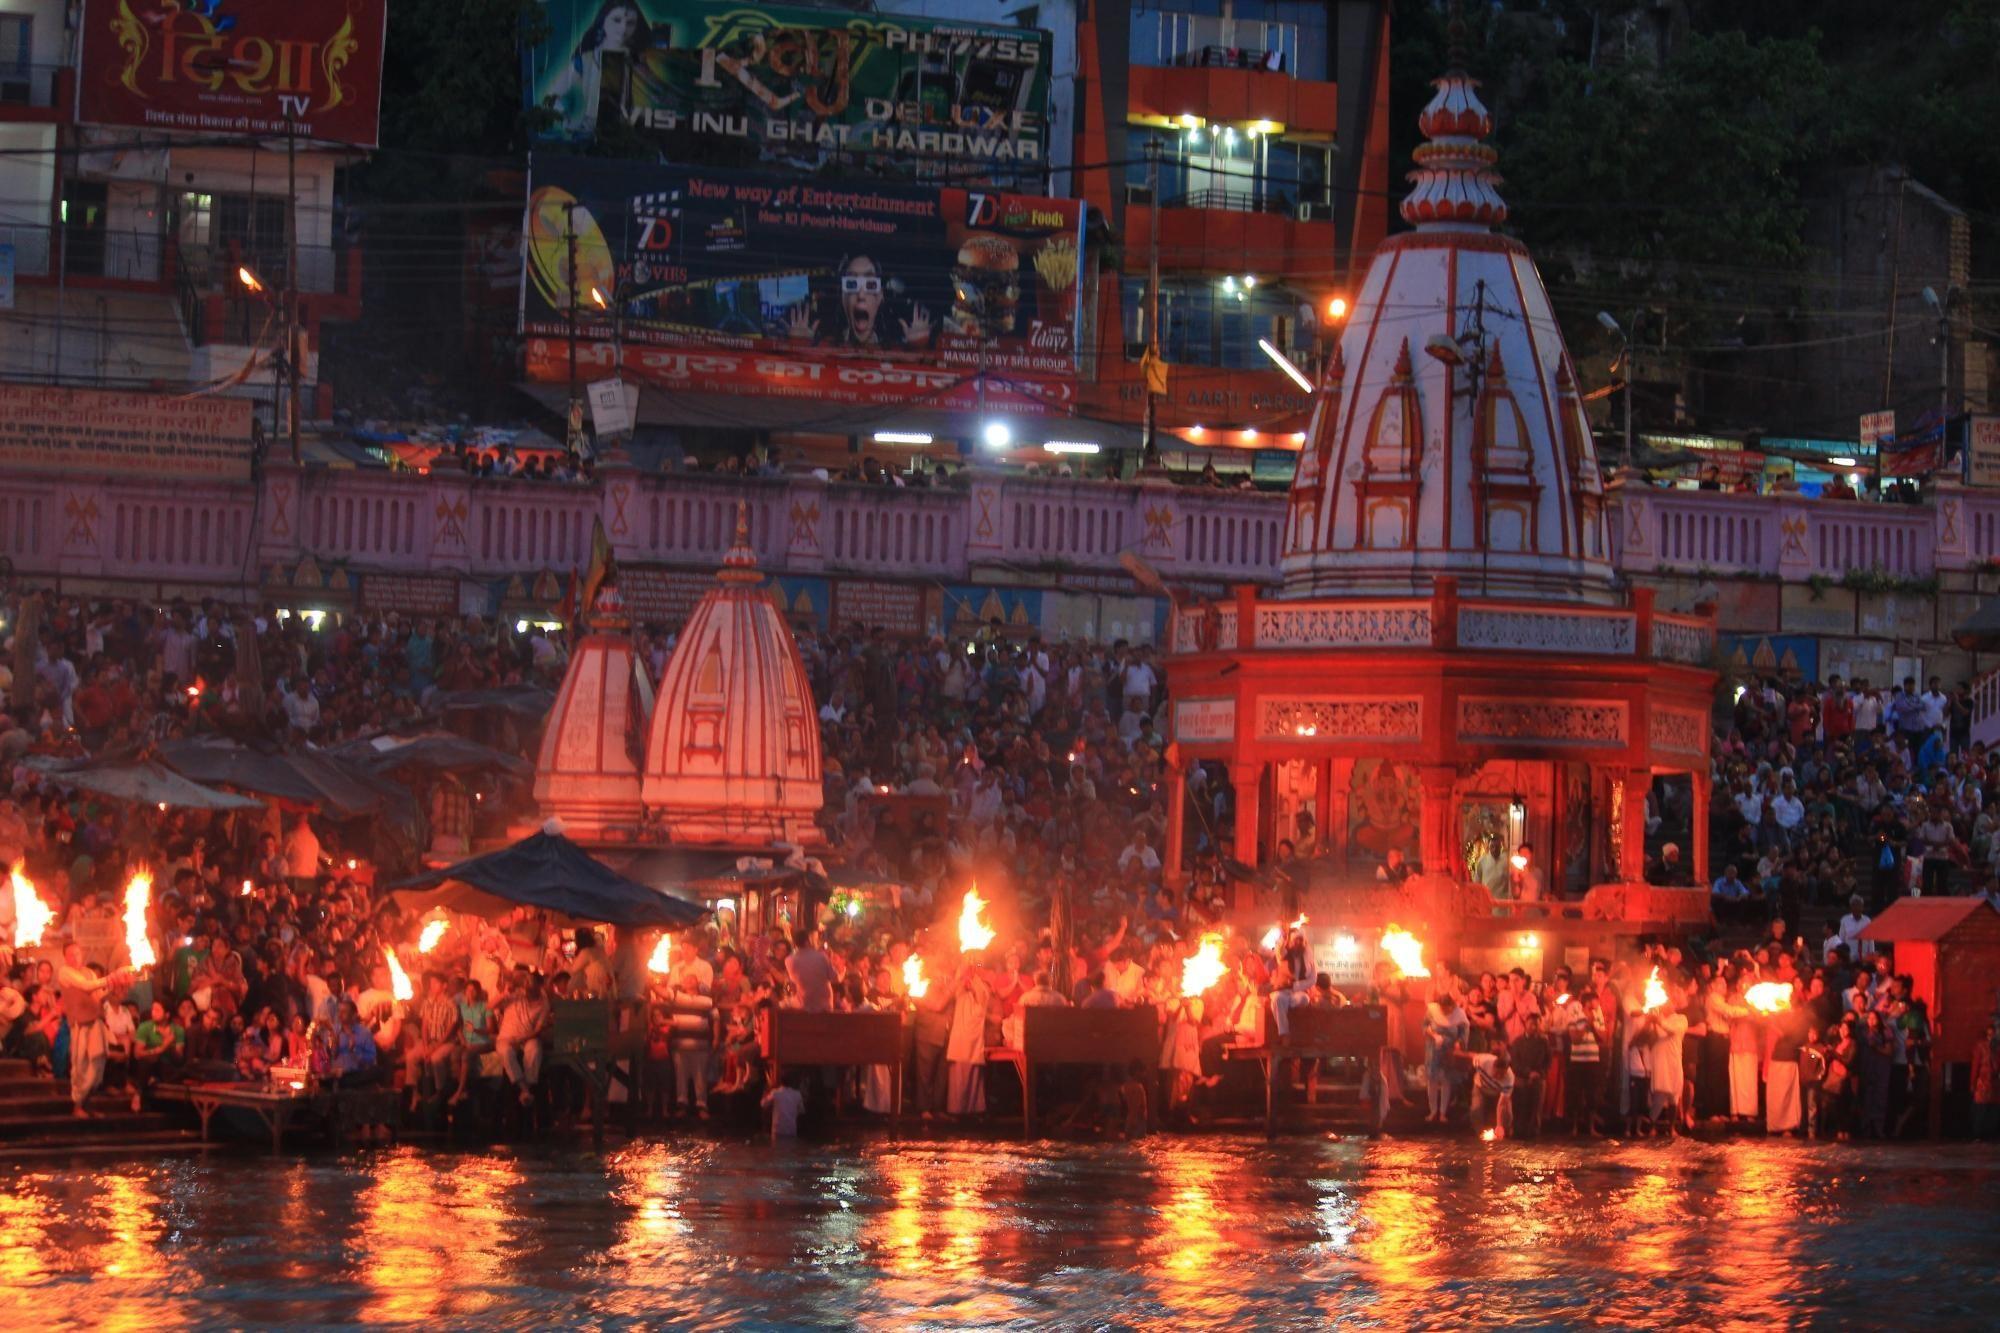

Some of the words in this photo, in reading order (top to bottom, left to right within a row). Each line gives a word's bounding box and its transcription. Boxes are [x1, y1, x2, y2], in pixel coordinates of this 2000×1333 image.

[159, 11, 319, 93] दिशा
[277, 95, 311, 116] TV
[864, 97, 1039, 132] DELUXE
[766, 118, 852, 145] GHAT
[871, 127, 1038, 160] HARDWAR
[688, 177, 730, 199] New
[734, 185, 773, 204] way
[776, 185, 798, 204] of
[801, 187, 935, 217] Entertainment
[968, 192, 997, 225] 7D
[1031, 208, 1064, 228] Foods
[943, 351, 993, 366] MANAGD
[995, 354, 1009, 366] BY
[1033, 356, 1068, 369] GROUP
[1188, 390, 1240, 408] AARTI
[1251, 391, 1316, 411] DARSHA
